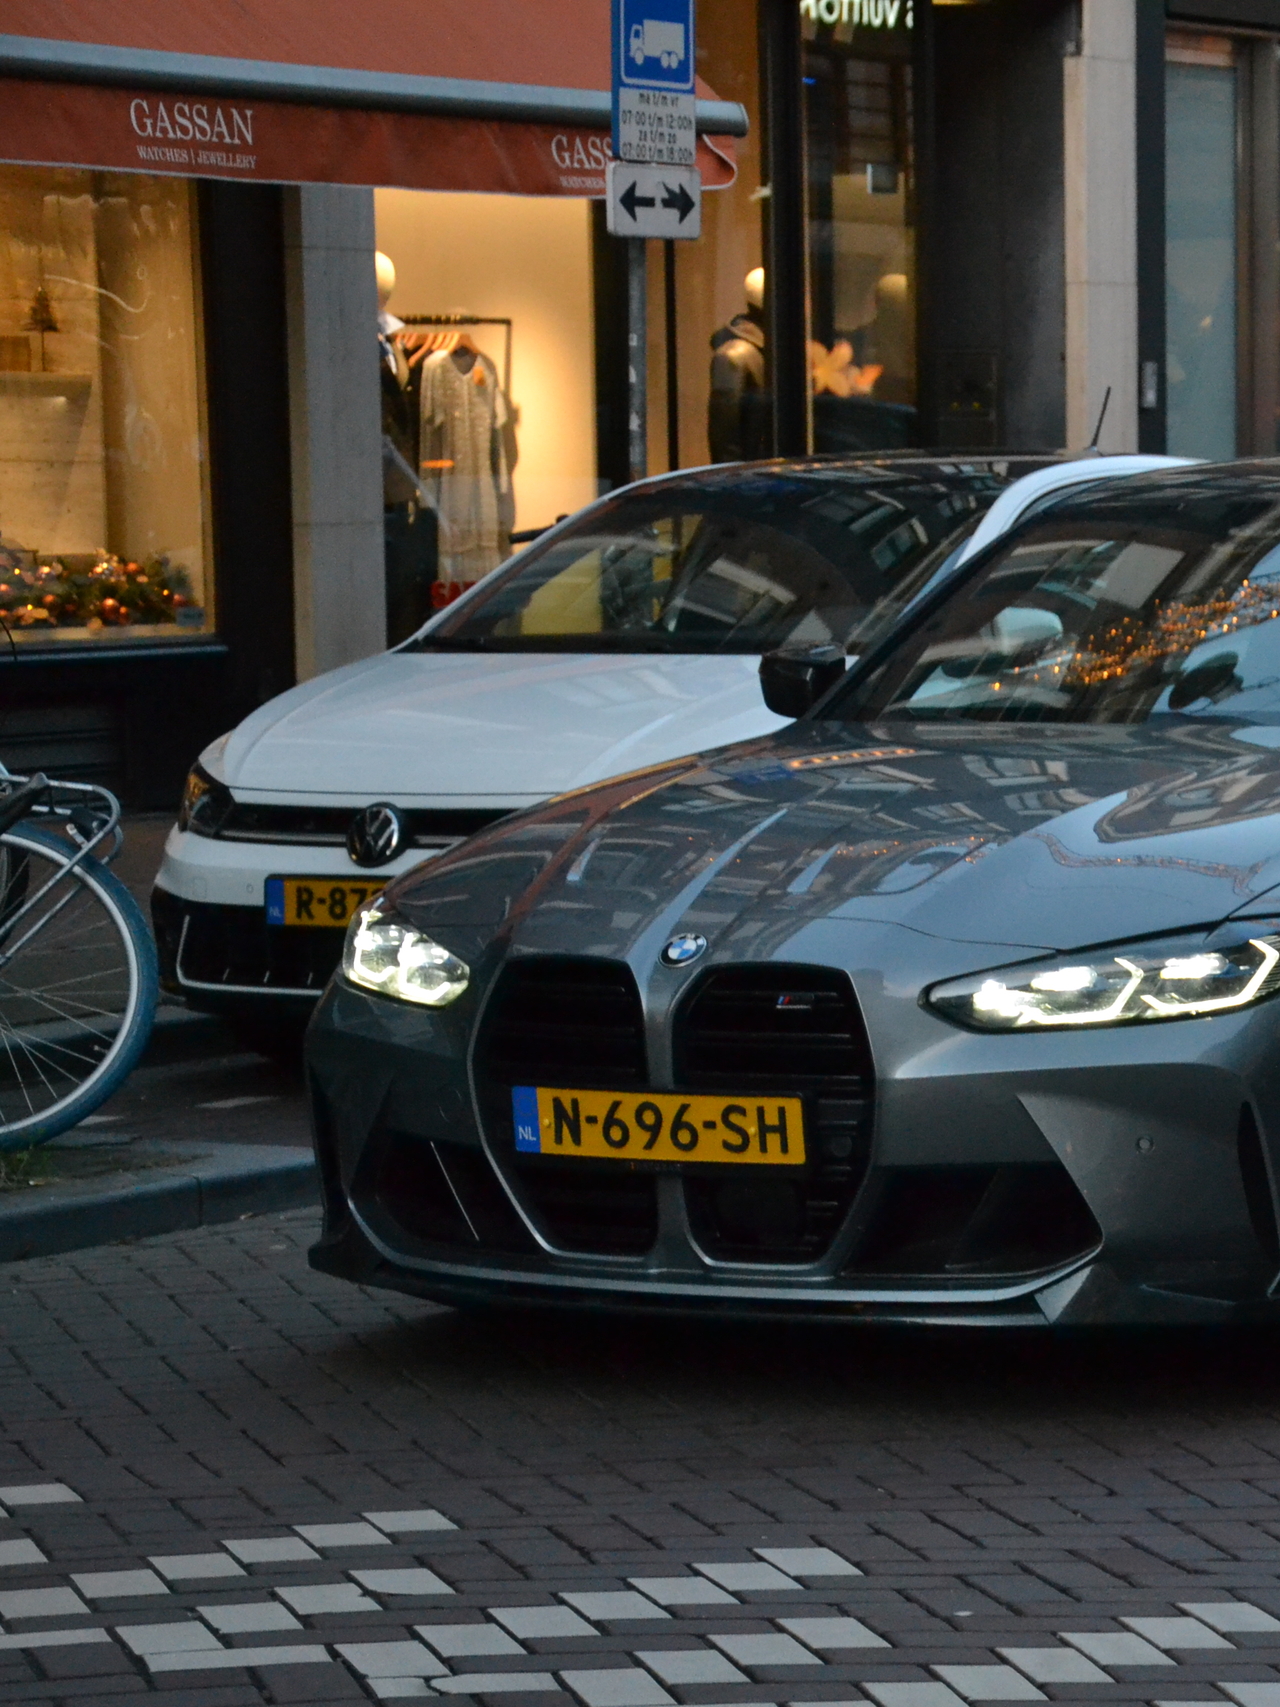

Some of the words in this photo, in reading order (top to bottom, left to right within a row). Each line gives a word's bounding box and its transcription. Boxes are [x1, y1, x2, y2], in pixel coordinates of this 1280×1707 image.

[130, 98, 253, 146] GASSAN
[137, 145, 189, 163] WATCHES
[197, 149, 257, 169] JEWELLERY
[295, 886, 384, 921] R-87
[518, 1125, 537, 1141] NL
[552, 1096, 789, 1155] N-696-SH
